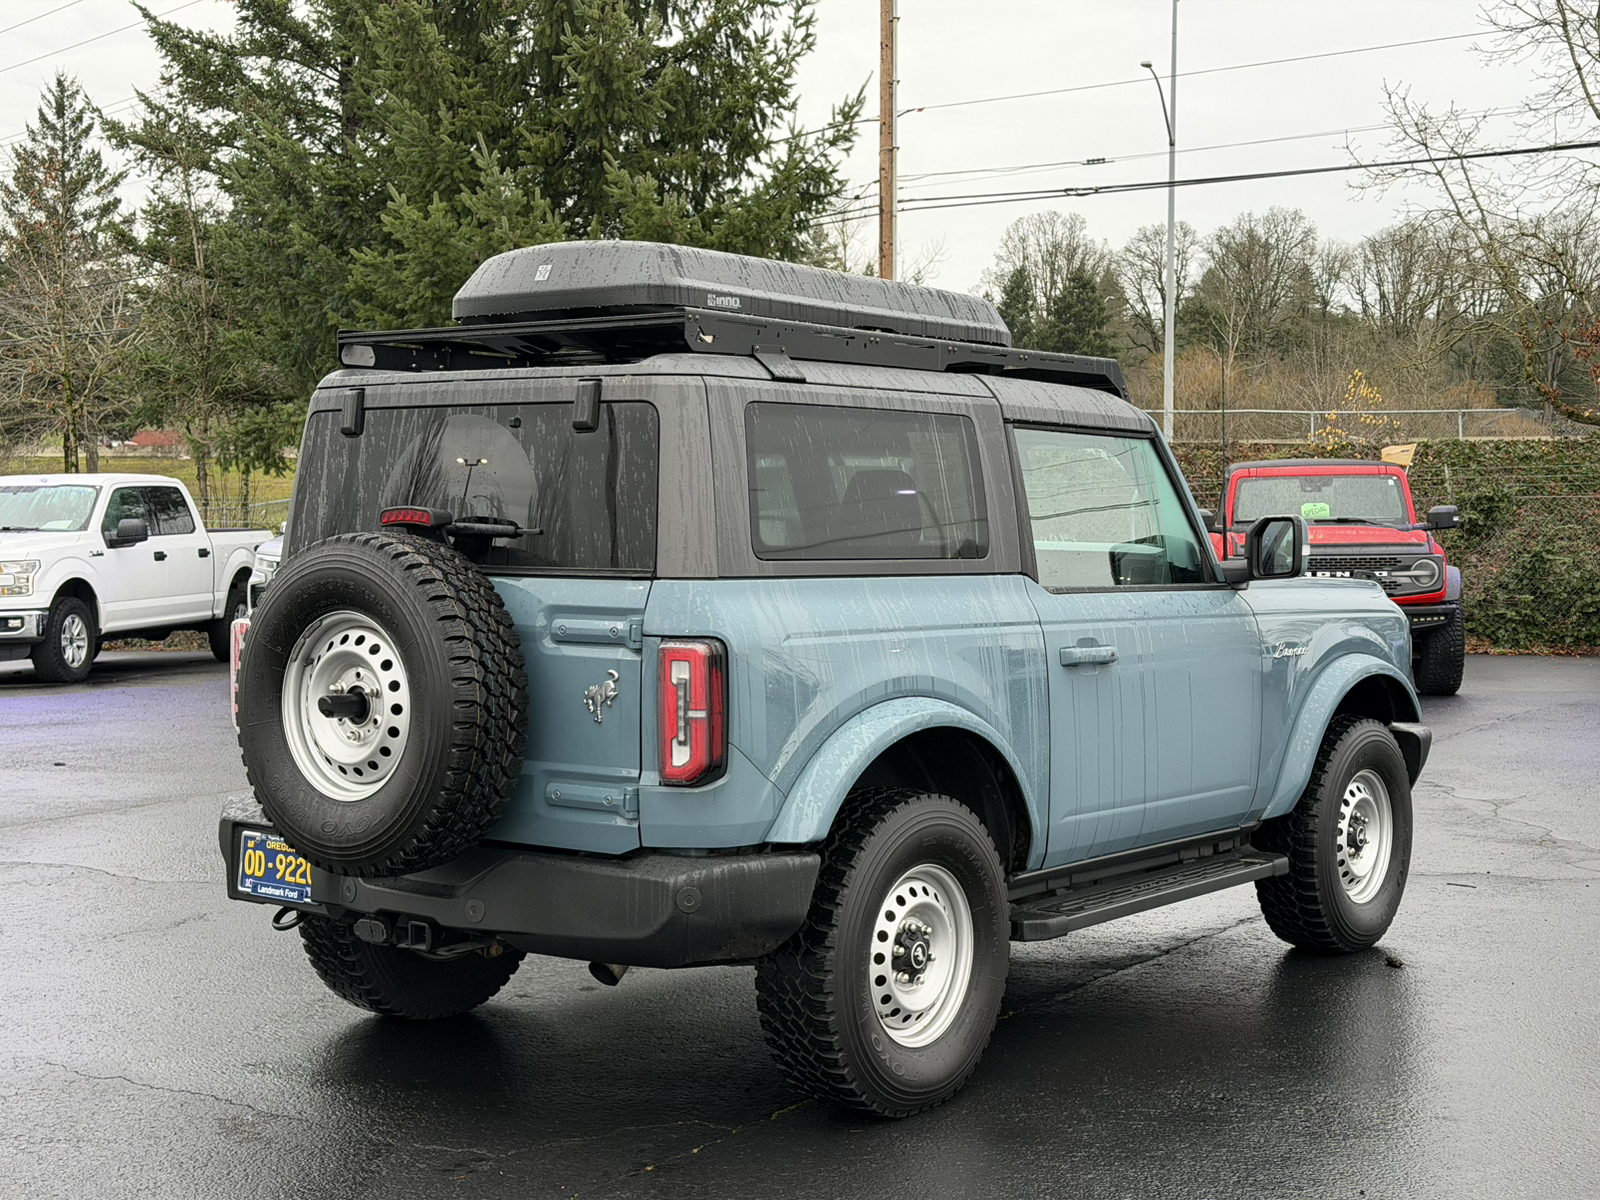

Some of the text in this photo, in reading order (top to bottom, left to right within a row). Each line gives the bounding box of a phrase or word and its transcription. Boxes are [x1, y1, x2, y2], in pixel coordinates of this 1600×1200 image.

[1303, 506, 1328, 518] SPECIAL
[1273, 641, 1308, 658] Bronco
[266, 840, 296, 853] OREG
[257, 884, 284, 896] Landmark
[285, 889, 298, 899] Ford
